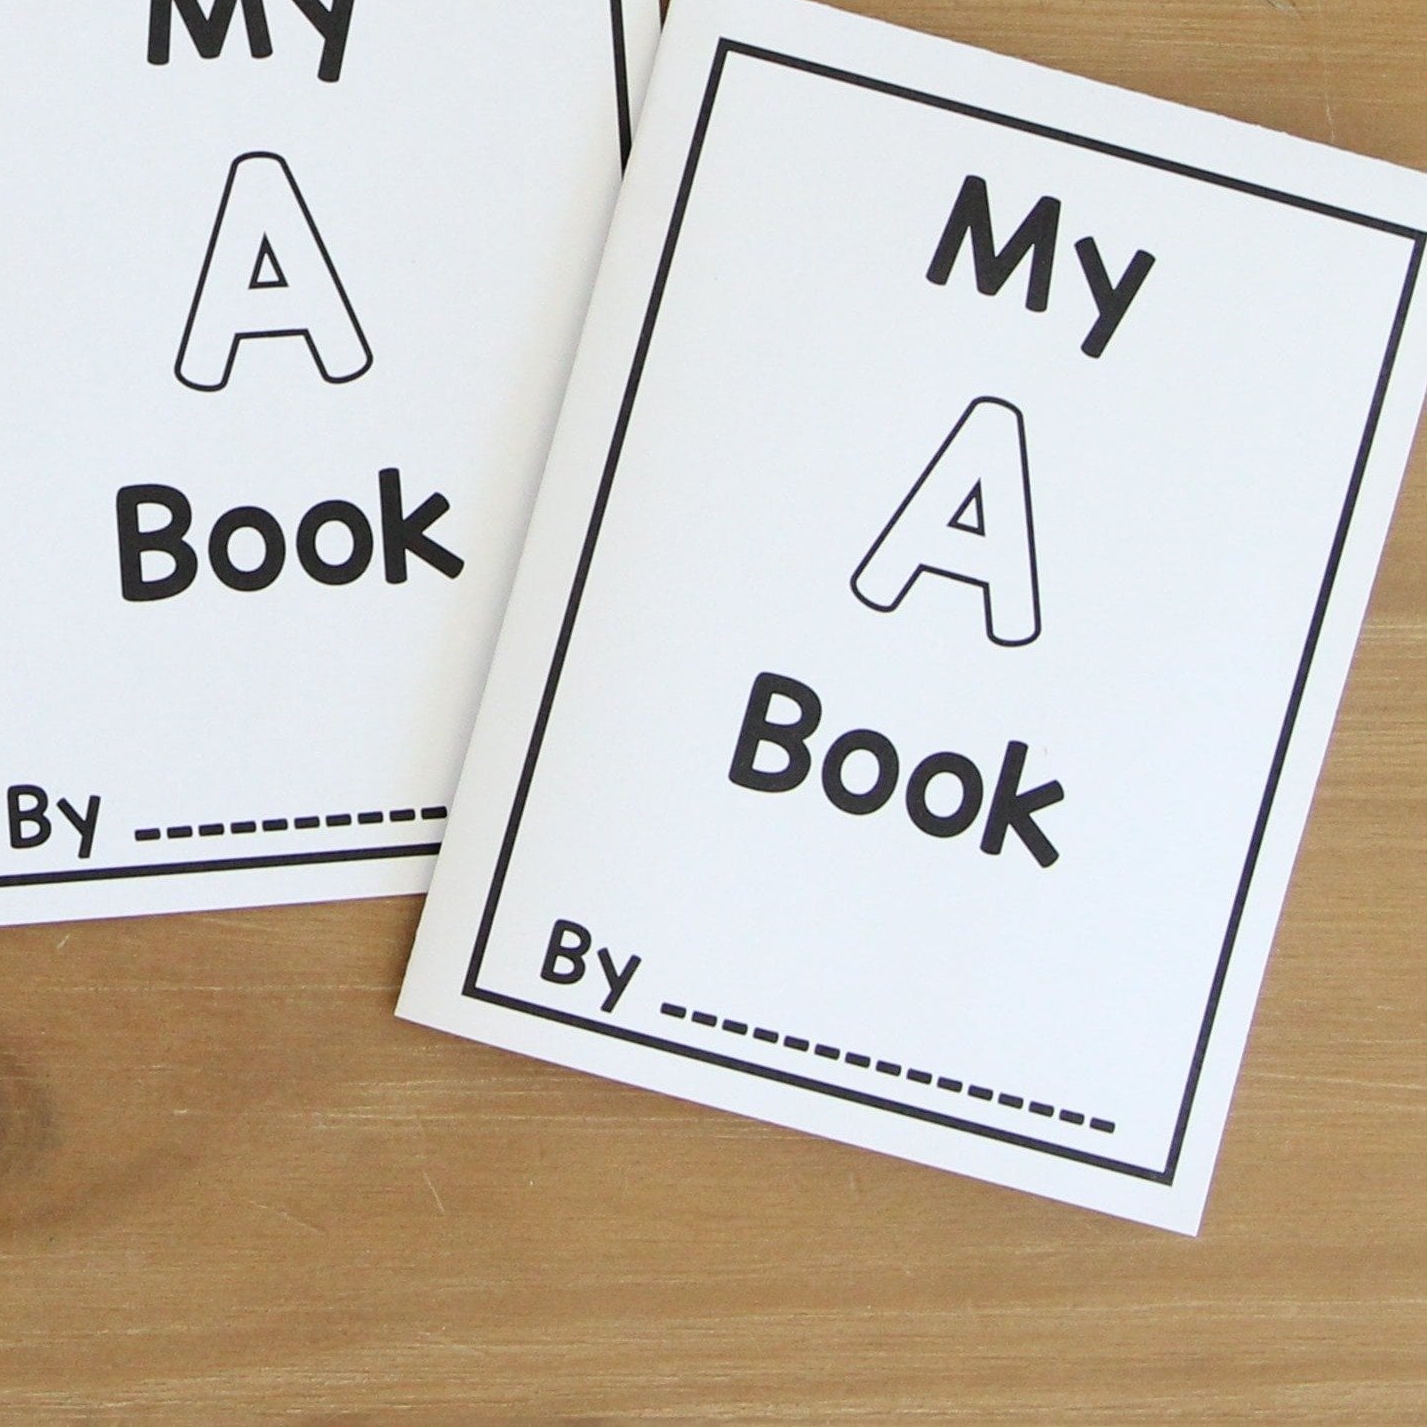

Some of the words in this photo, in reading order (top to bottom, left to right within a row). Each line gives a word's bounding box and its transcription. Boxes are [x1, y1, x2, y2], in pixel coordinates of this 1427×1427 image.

[174, 150, 375, 394] A
[924, 174, 1156, 360] My
[115, 466, 465, 603] Book
[849, 394, 1043, 649] A
[6, 783, 102, 860] By
[727, 670, 1066, 870] Book
[538, 918, 644, 1016] By
